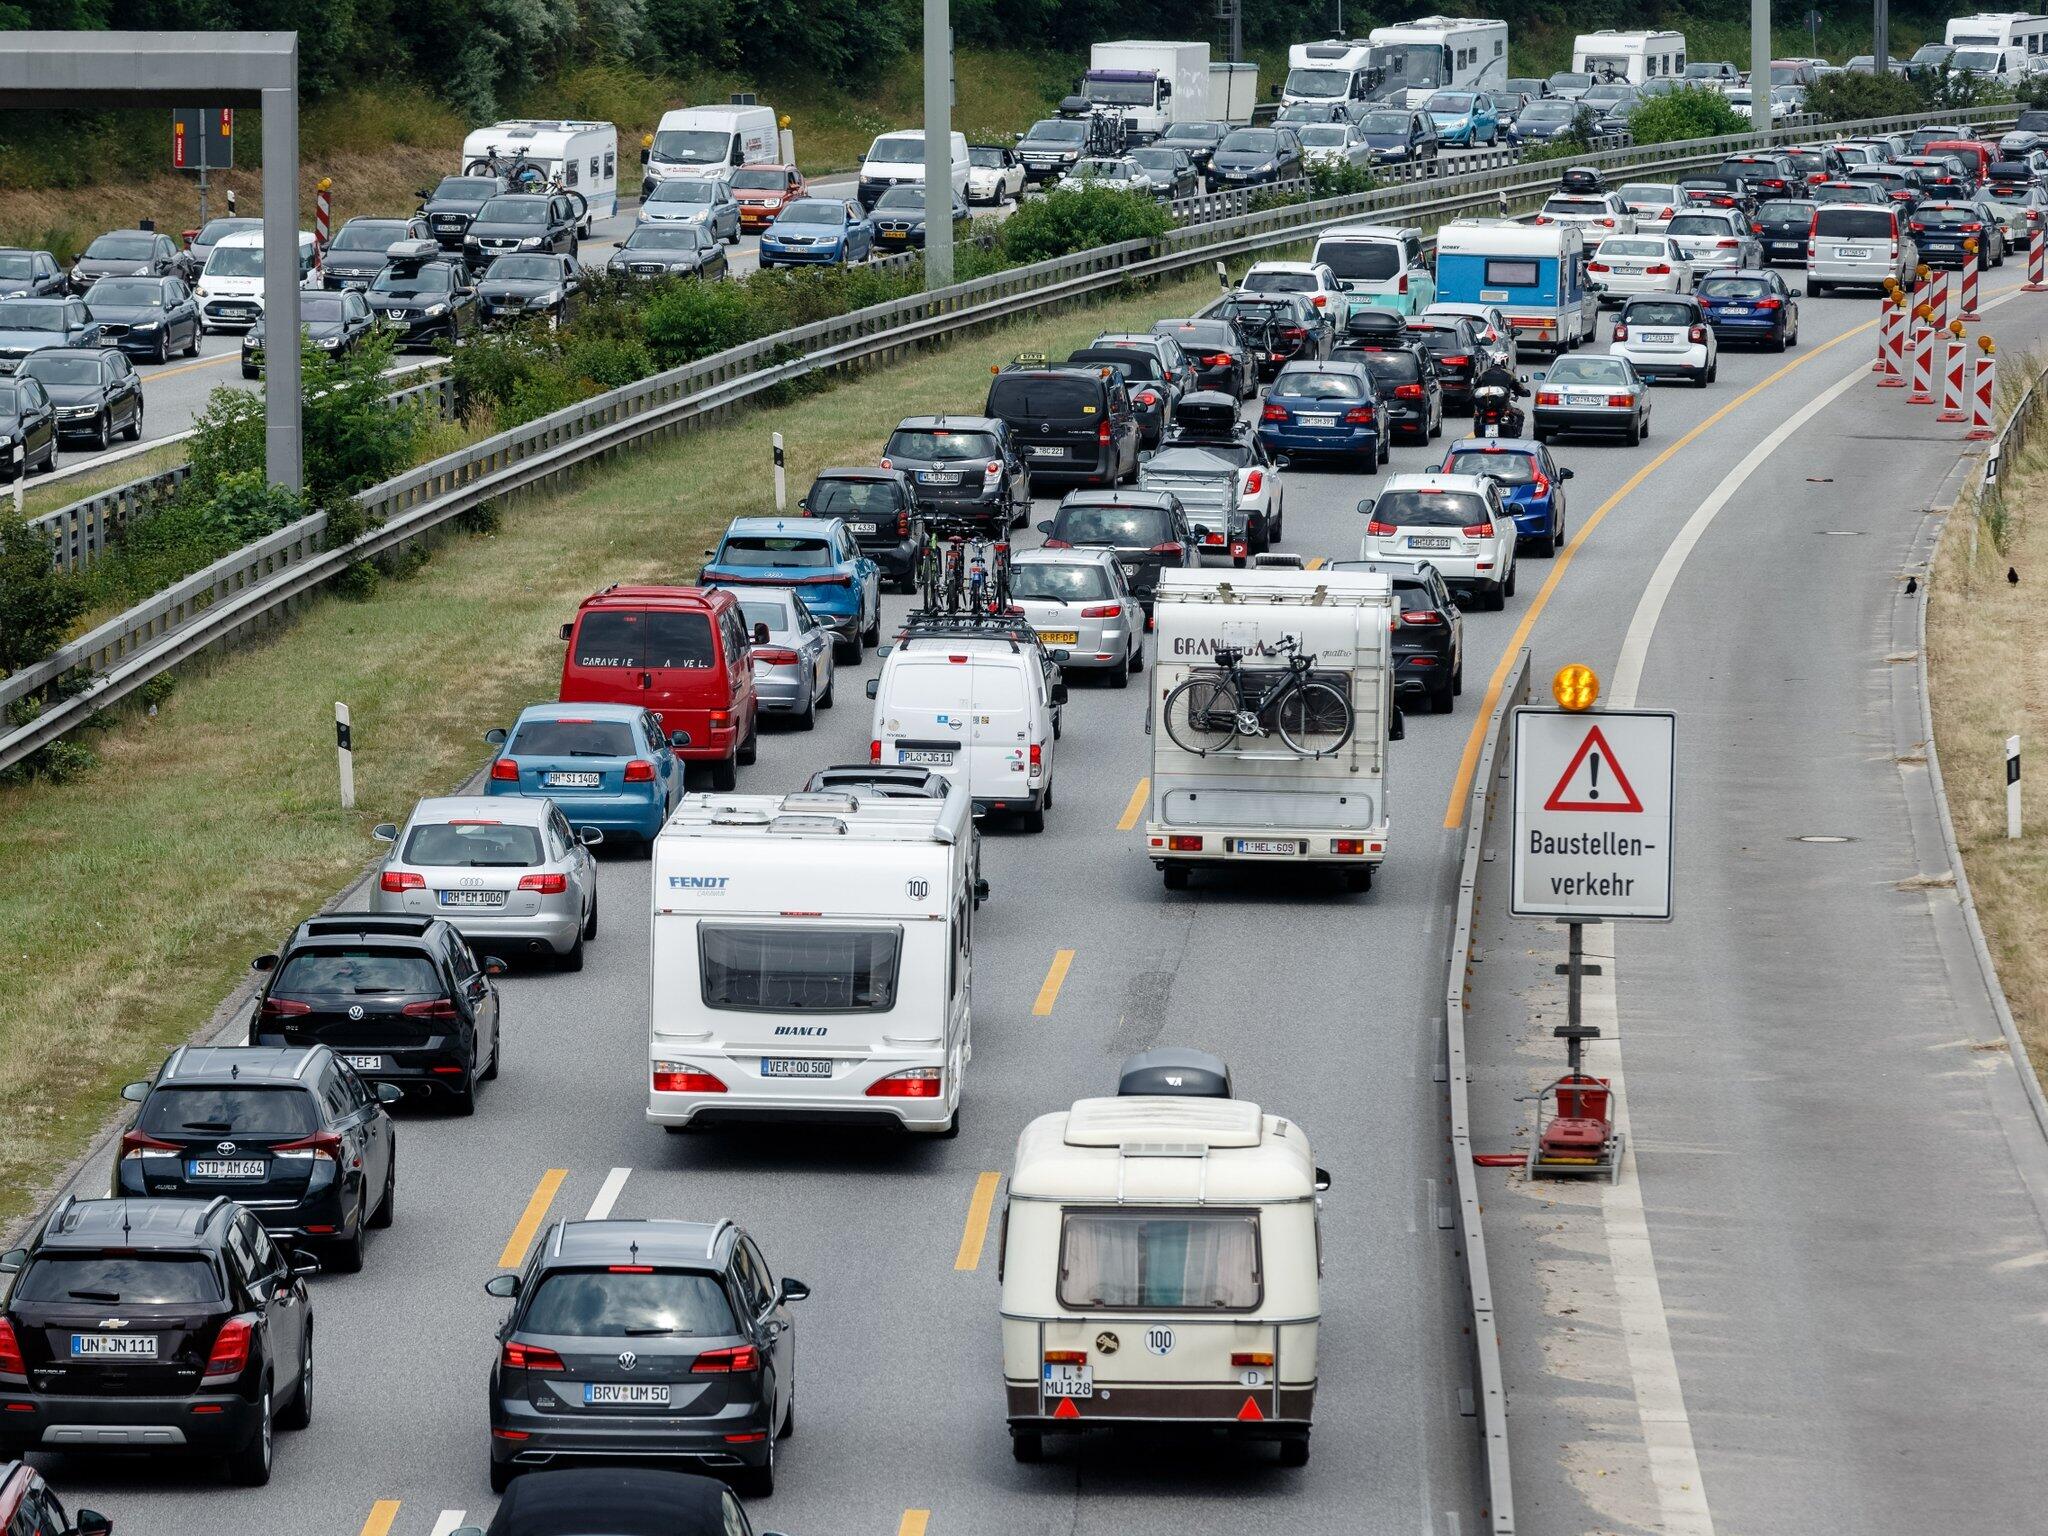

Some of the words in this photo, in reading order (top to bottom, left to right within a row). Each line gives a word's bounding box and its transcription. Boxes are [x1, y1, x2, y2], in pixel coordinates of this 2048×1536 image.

[905, 751, 922, 762] PLÖ
[927, 753, 939, 762] JG
[940, 753, 951, 763] 11
[550, 773, 560, 781] HH
[566, 773, 576, 782] SI
[579, 774, 599, 783] 1406
[1530, 830, 1655, 856] Baustellen-
[669, 876, 730, 888] FENDT
[1550, 872, 1634, 896] verkehr
[909, 880, 928, 897] 100
[448, 892, 460, 902] RH
[466, 892, 478, 902] EM
[480, 893, 502, 903] 1006
[774, 1026, 828, 1036] BIANCO
[357, 1057, 371, 1067] EF
[374, 1057, 380, 1067] 1
[769, 1061, 789, 1072] VER
[811, 1062, 830, 1073] 500
[198, 1161, 218, 1173] STD
[227, 1161, 241, 1173] AM
[243, 1161, 263, 1173] 664
[82, 1338, 100, 1352] UN
[109, 1338, 127, 1352] JN
[130, 1339, 155, 1353] 111
[1149, 1331, 1171, 1348] 100
[1063, 1367, 1071, 1379] L
[1248, 1371, 1258, 1384] D
[593, 1386, 621, 1400] BRV
[630, 1387, 648, 1400] UM
[651, 1387, 668, 1400] 50
[1066, 1382, 1091, 1394] 128
